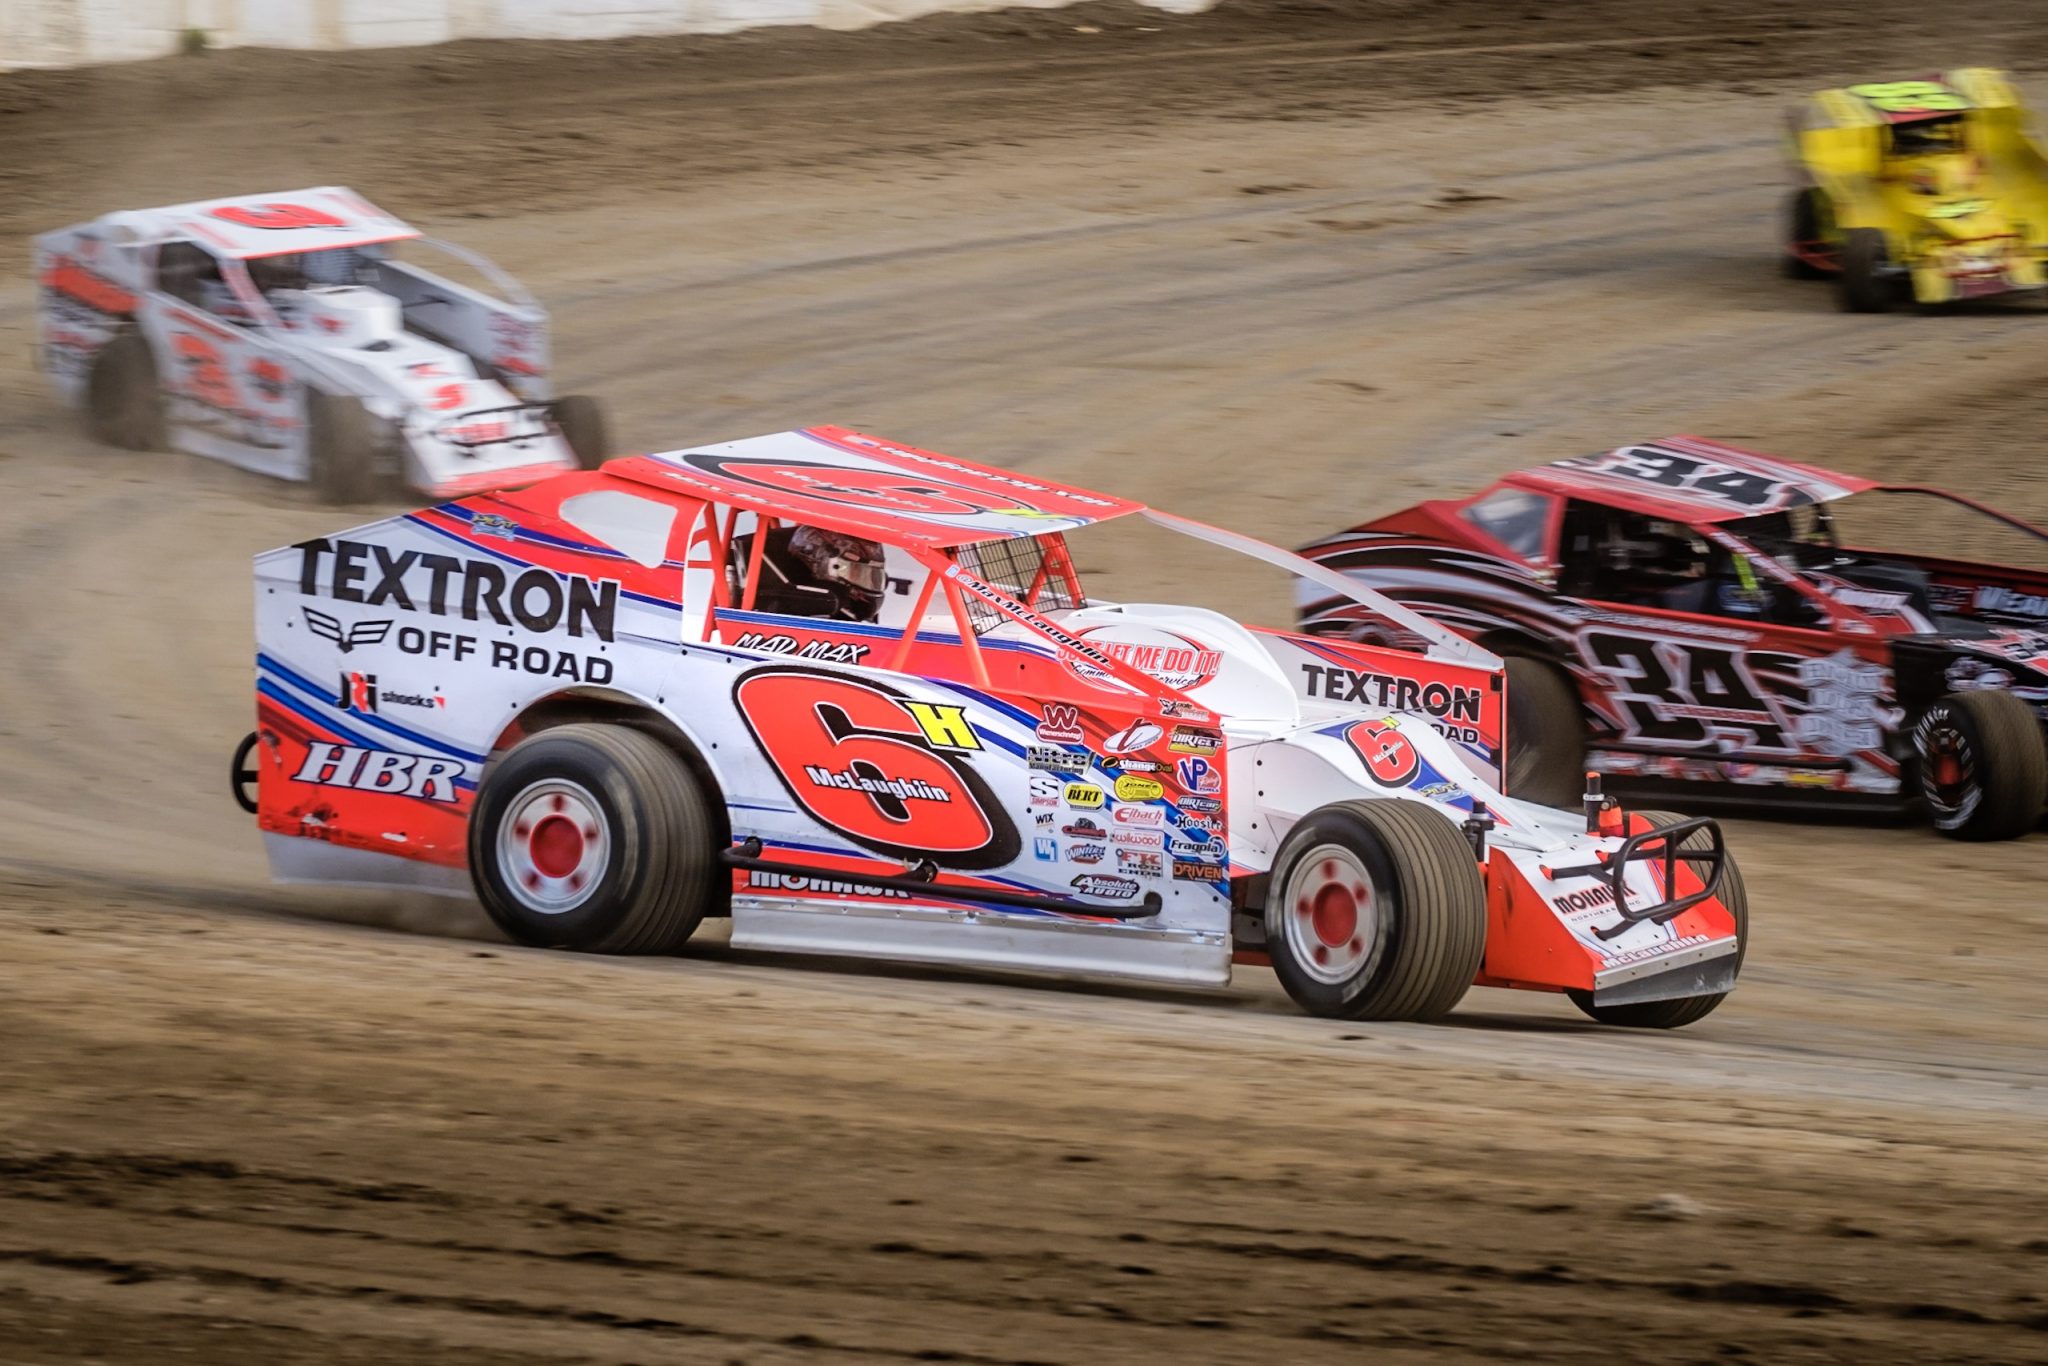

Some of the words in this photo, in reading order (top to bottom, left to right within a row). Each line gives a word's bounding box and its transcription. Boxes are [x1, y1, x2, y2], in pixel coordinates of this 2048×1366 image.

[291, 537, 621, 644] TEXTRON
[399, 626, 478, 662] OFF
[492, 639, 614, 686] ROAD
[733, 631, 799, 654] MAD
[796, 638, 870, 664] MAX
[1131, 644, 1163, 671] ME
[1161, 646, 1196, 673] DO
[1193, 650, 1224, 676] IT!
[381, 691, 435, 709] shocks
[1302, 663, 1482, 722] TEXTRON
[1430, 723, 1479, 744] OAD
[291, 739, 467, 803] HBR
[731, 664, 1023, 871] 6
[1180, 758, 1208, 791] VP
[804, 764, 952, 803] McLaughlin
[1067, 789, 1102, 802] BERT
[1035, 813, 1054, 825] WIX
[1114, 807, 1163, 825] Eibach
[1175, 815, 1222, 831] Hoosier
[1115, 832, 1162, 846] wilwood
[1171, 840, 1218, 854] Fragola
[1121, 852, 1161, 865] FK
[1173, 863, 1222, 880] DRIVEN
[1077, 876, 1138, 890] Absolute
